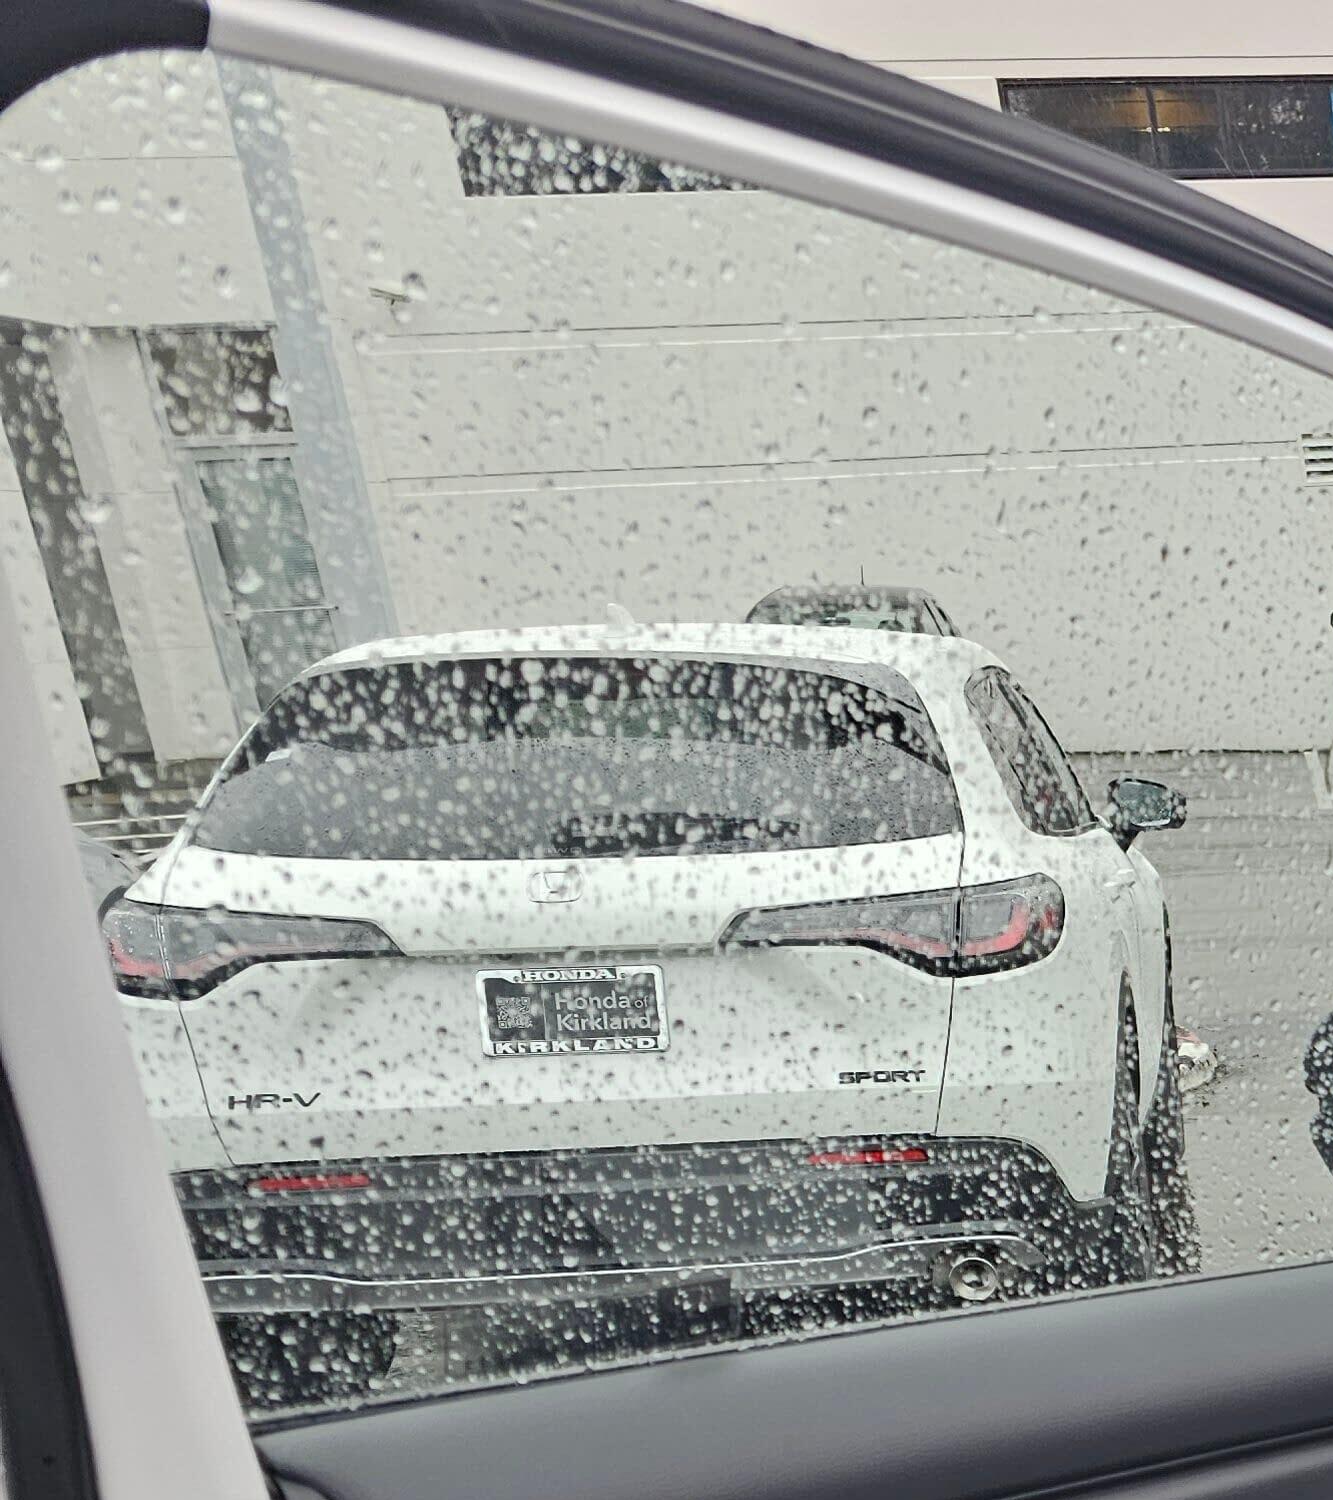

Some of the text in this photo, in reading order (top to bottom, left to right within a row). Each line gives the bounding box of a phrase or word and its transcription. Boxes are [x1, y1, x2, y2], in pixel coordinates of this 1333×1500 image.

[522, 968, 616, 982] HONDA
[554, 990, 648, 1010] Honda of
[556, 1011, 651, 1032] Kirkland
[495, 1037, 657, 1055] KIRKLAND
[838, 1069, 926, 1085] SPORT
[227, 1092, 321, 1110] HR-V
